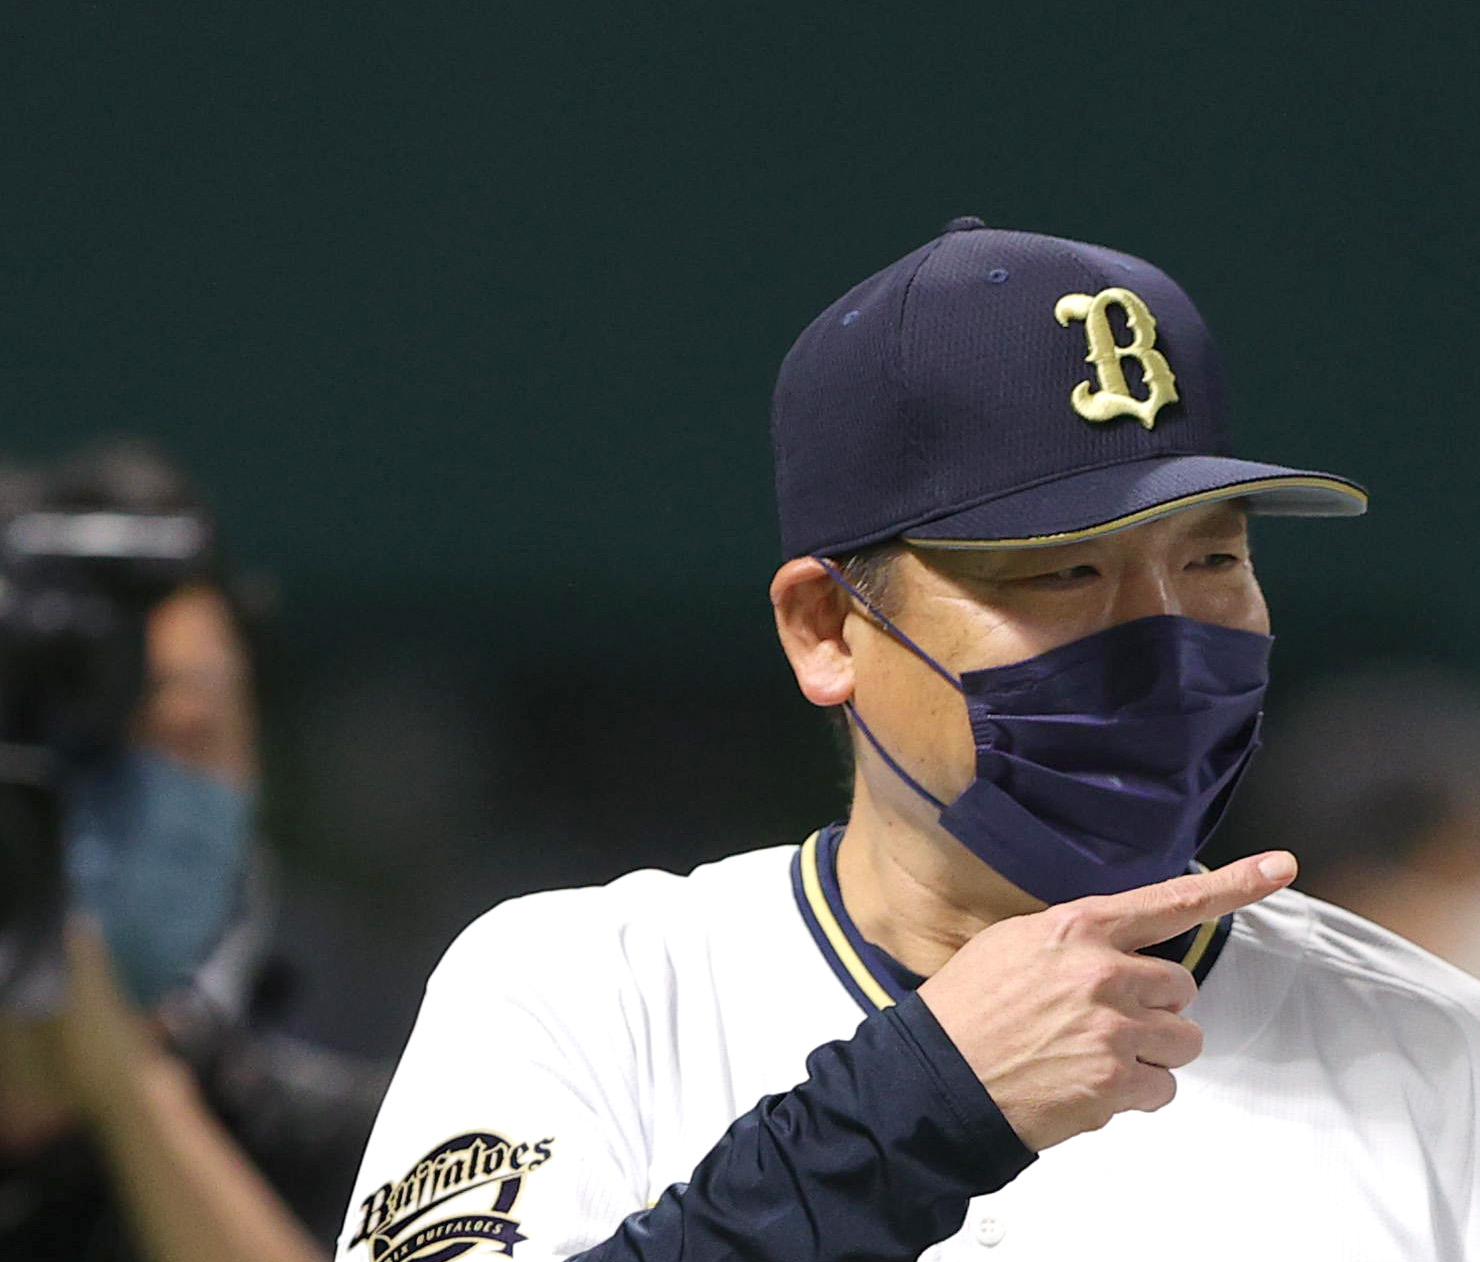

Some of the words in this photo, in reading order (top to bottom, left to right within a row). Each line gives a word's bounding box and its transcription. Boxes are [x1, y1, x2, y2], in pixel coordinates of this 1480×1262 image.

[1055, 287, 1180, 430] B
[347, 1137, 555, 1250] Buffaloes
[416, 1220, 504, 1246] BUFFALOES
